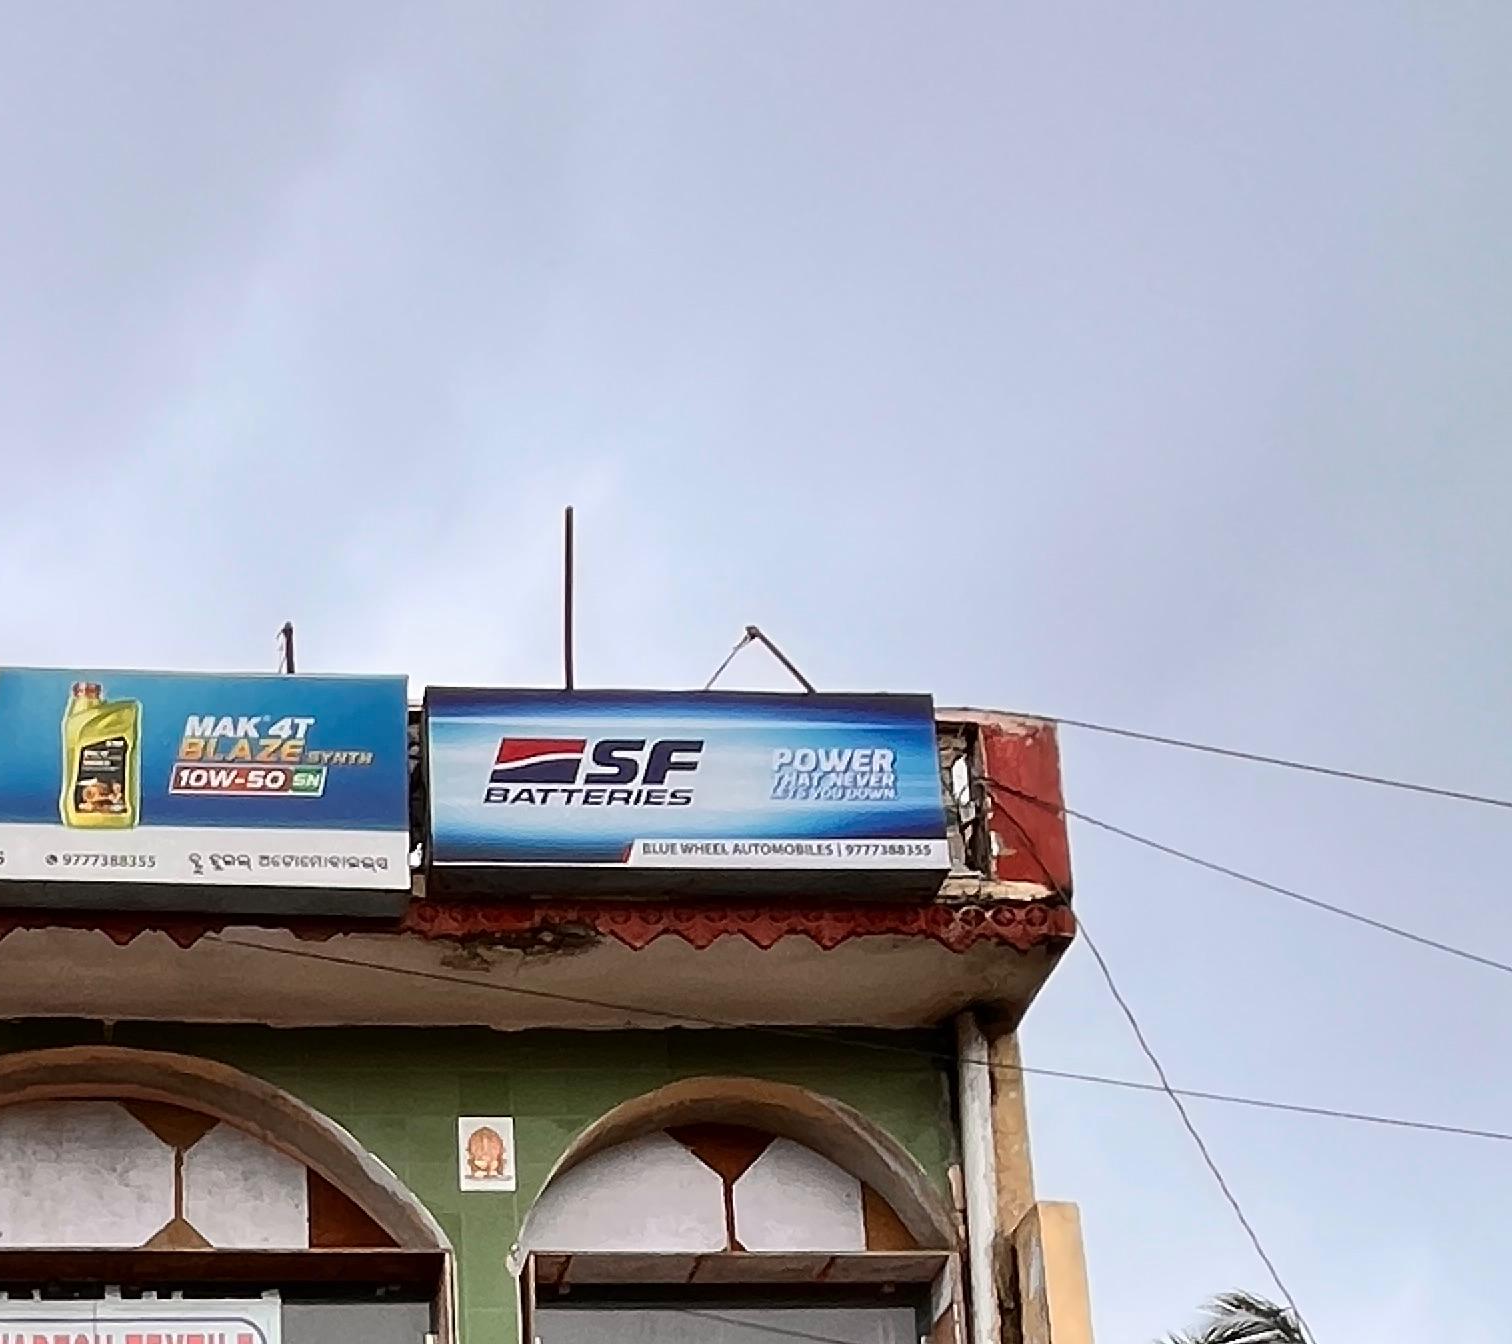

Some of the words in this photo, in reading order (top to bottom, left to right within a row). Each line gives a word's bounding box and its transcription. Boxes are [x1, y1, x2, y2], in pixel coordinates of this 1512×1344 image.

[186, 715, 260, 738] MAK
[268, 717, 315, 739] 4T
[180, 738, 305, 762] BLAZE
[772, 748, 894, 772] POWER
[589, 739, 704, 785] SF
[176, 768, 286, 789] 10W-50
[292, 771, 320, 787] SN
[829, 772, 894, 786] NEVER
[484, 788, 693, 807] BATTERIES
[642, 843, 678, 855] BLUE
[680, 843, 729, 855] WHEEL
[732, 843, 834, 856] AUTOMOBILES
